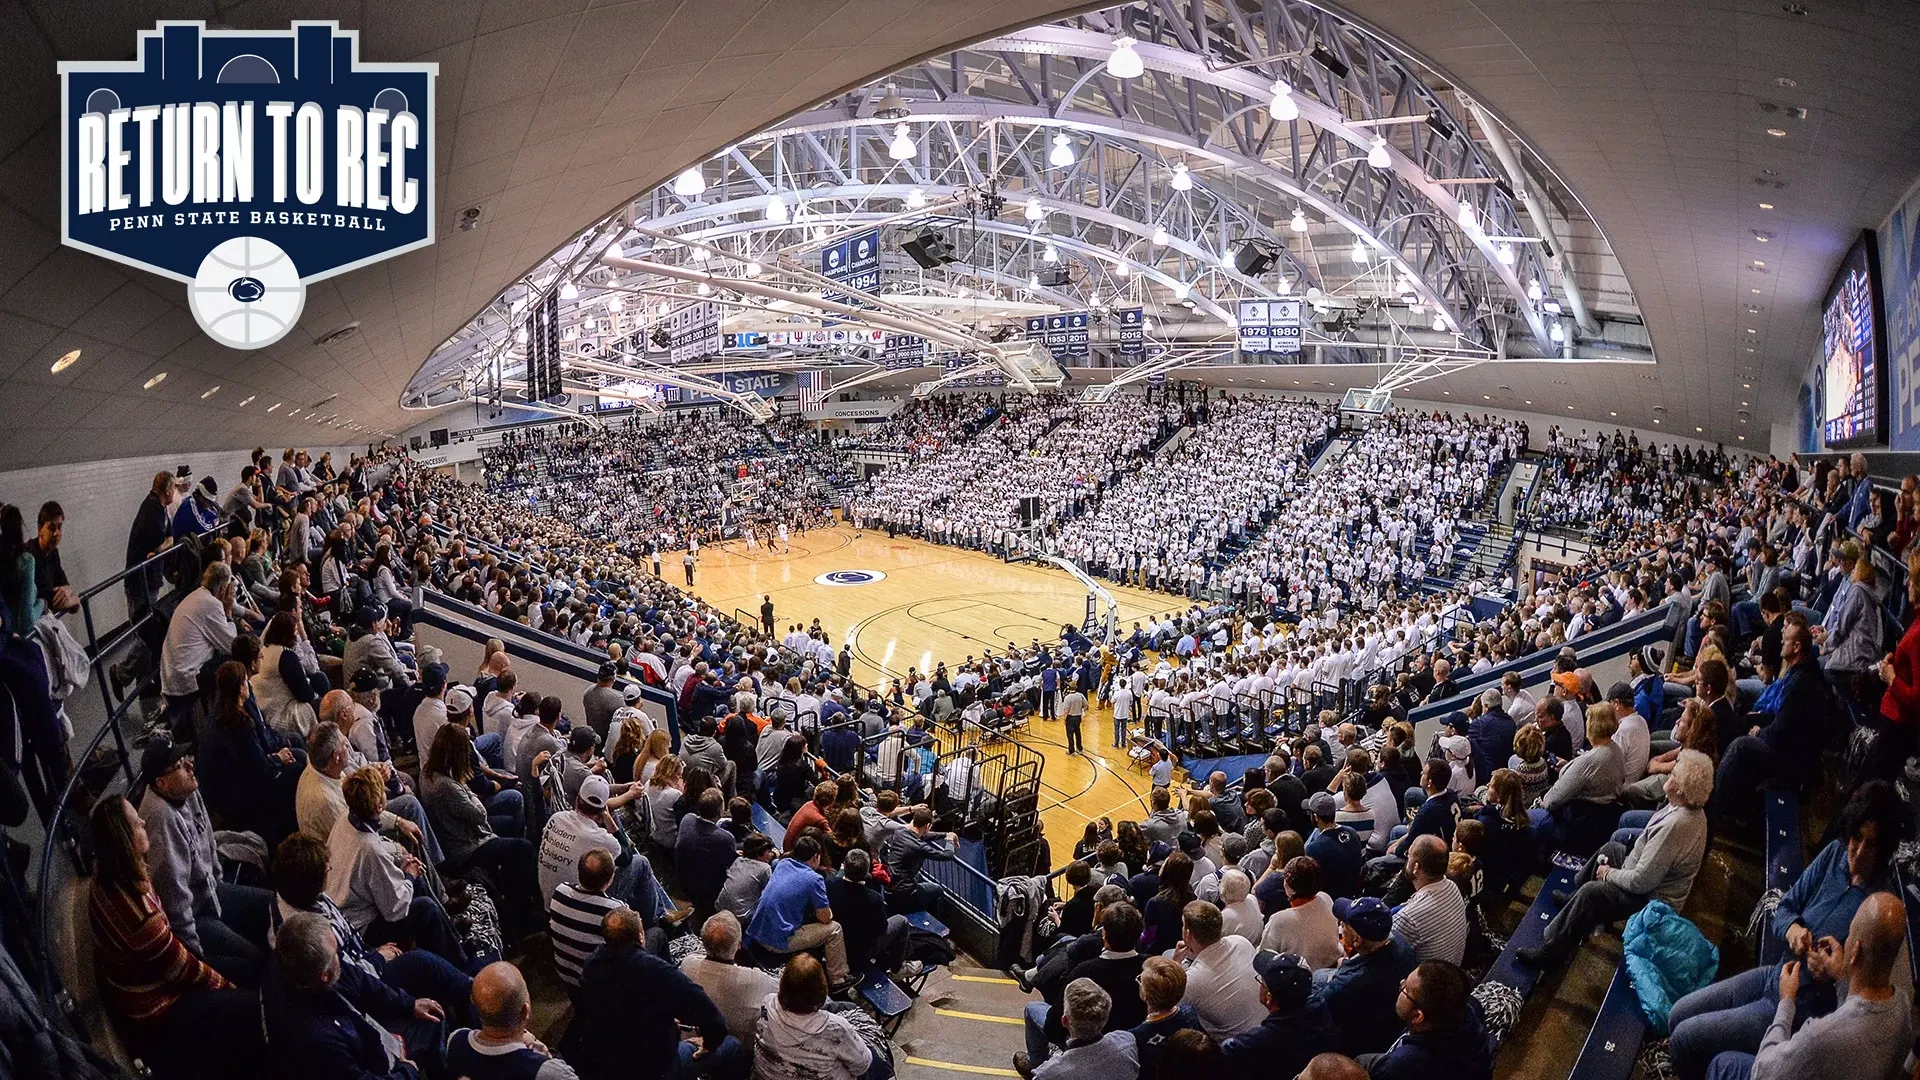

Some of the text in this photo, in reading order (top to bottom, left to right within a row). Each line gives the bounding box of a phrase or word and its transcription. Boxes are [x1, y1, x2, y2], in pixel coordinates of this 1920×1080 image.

[850, 272, 878, 290] 1994
[1120, 331, 1142, 339] 2012
[1242, 327, 1268, 336] 1978
[1271, 327, 1299, 336] 1980
[1068, 334, 1087, 342] 2011
[735, 374, 780, 393] STATE
[834, 409, 880, 417] CONCESSIONS
[546, 819, 576, 842] Student
[544, 830, 571, 852] Athletic
